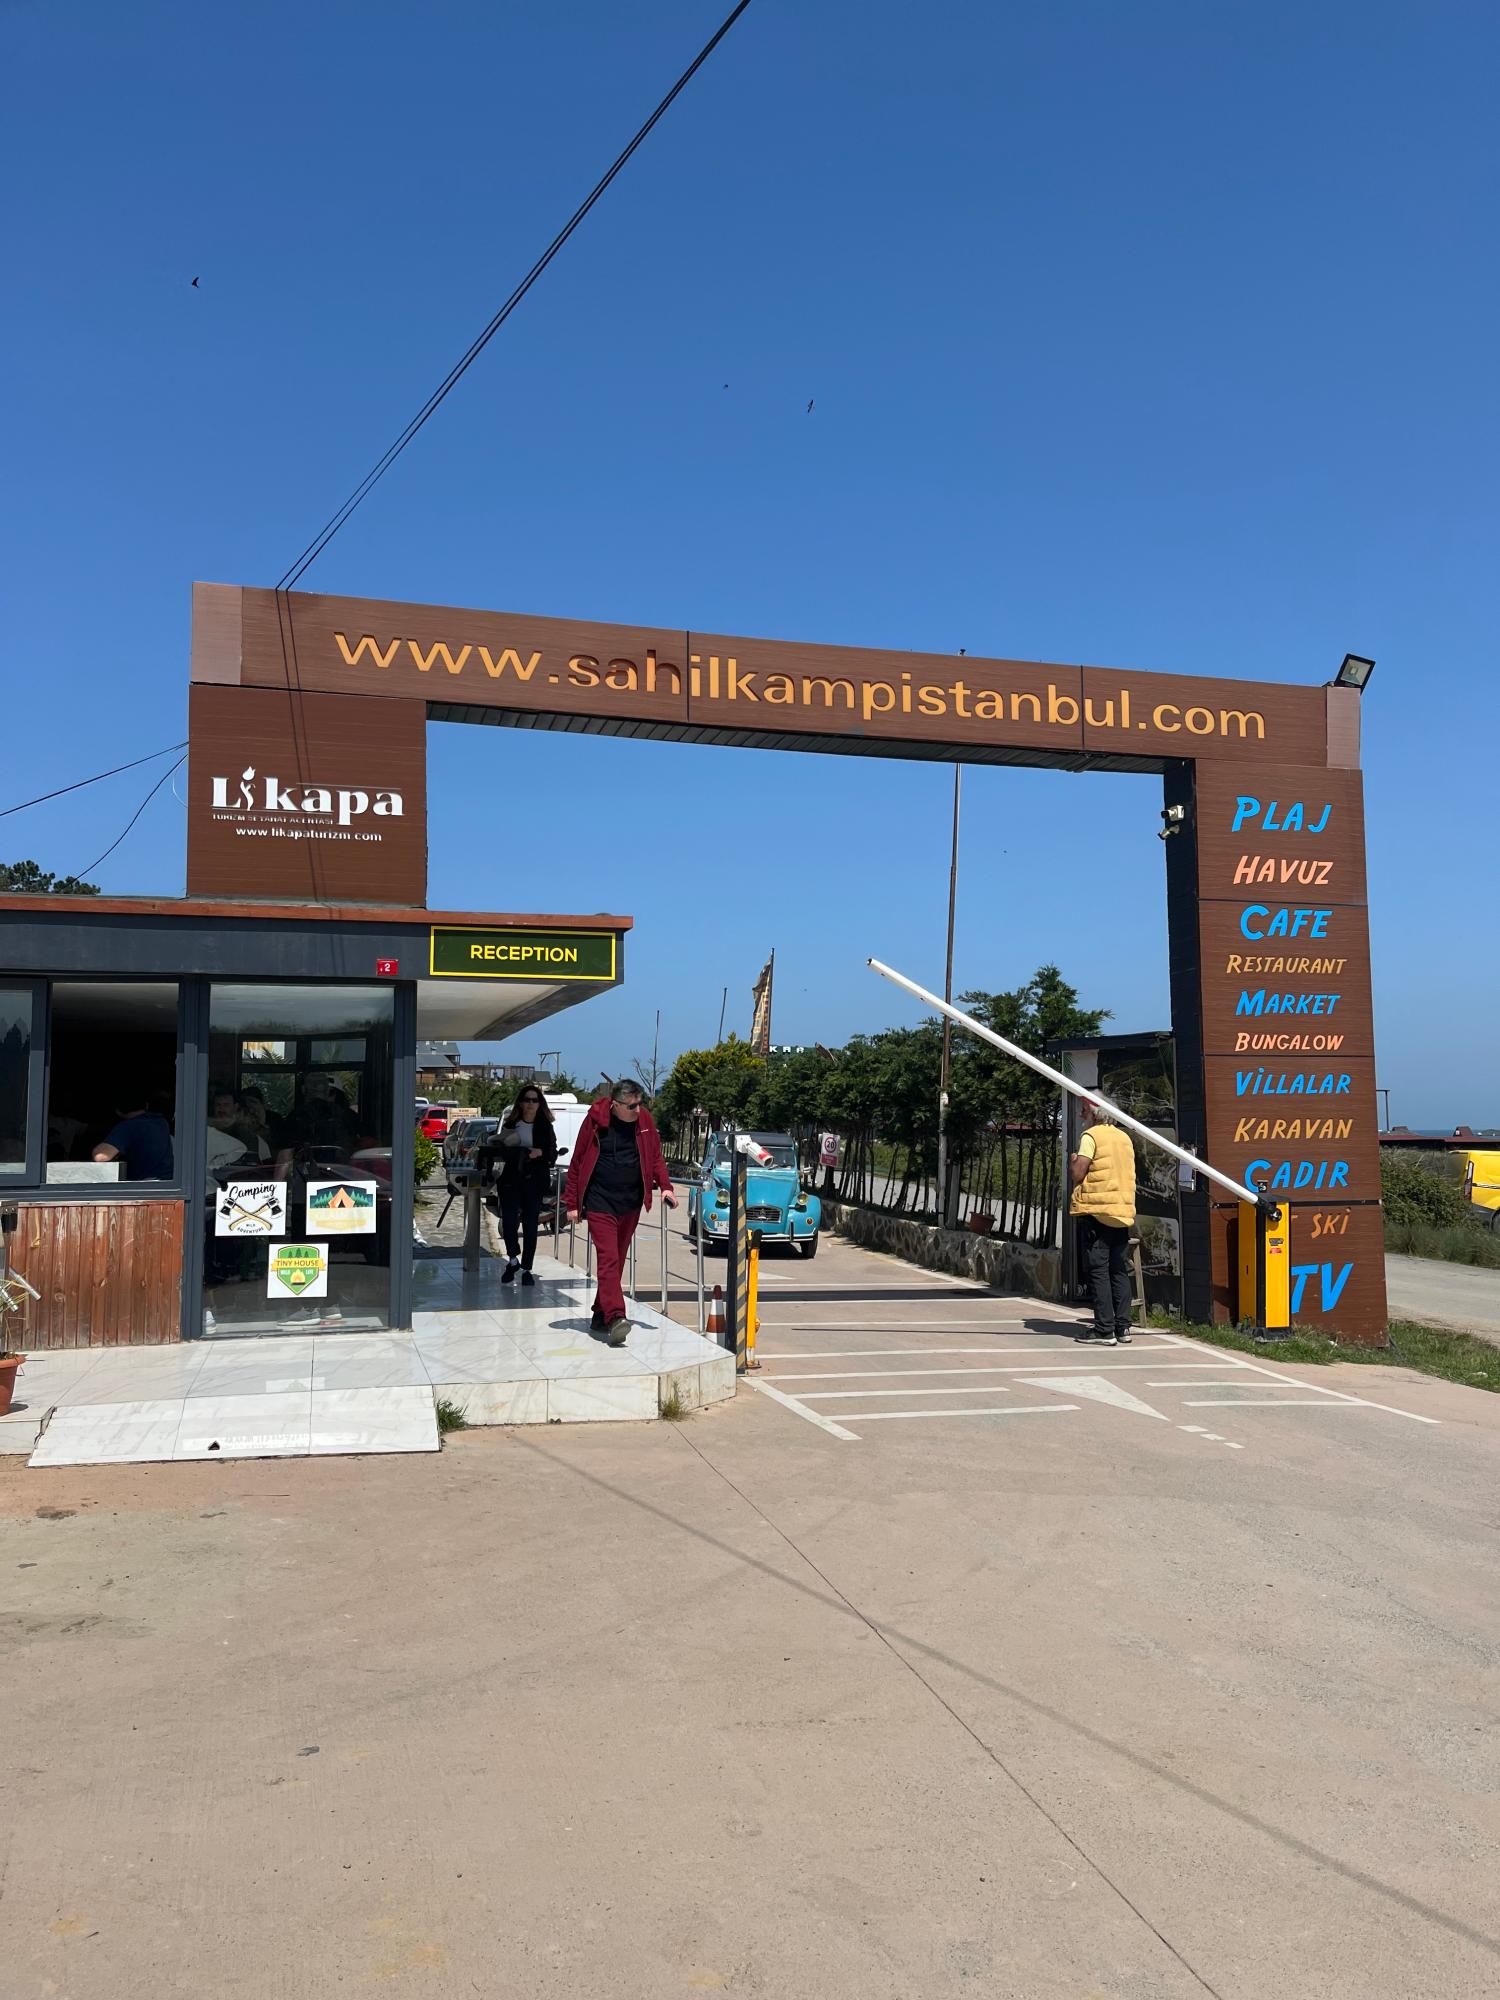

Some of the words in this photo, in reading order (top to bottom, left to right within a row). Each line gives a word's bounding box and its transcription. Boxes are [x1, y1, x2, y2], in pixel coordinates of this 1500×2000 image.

[334, 631, 1266, 739] www.sahilkampistanbul.com
[211, 766, 405, 826] Likapa
[1231, 795, 1333, 833] PLAJ
[1233, 855, 1334, 885] HAVUZ
[1240, 904, 1333, 941] CAFE
[470, 944, 578, 963] RECEPTION
[1226, 954, 1347, 975] RESTAURANT
[1235, 988, 1341, 1017] MARKET
[1234, 1031, 1345, 1052] BUNGALOW
[1233, 1117, 1353, 1143] KARAVAN
[229, 1183, 278, 1201] Camping
[1290, 1262, 1354, 1315] TV
